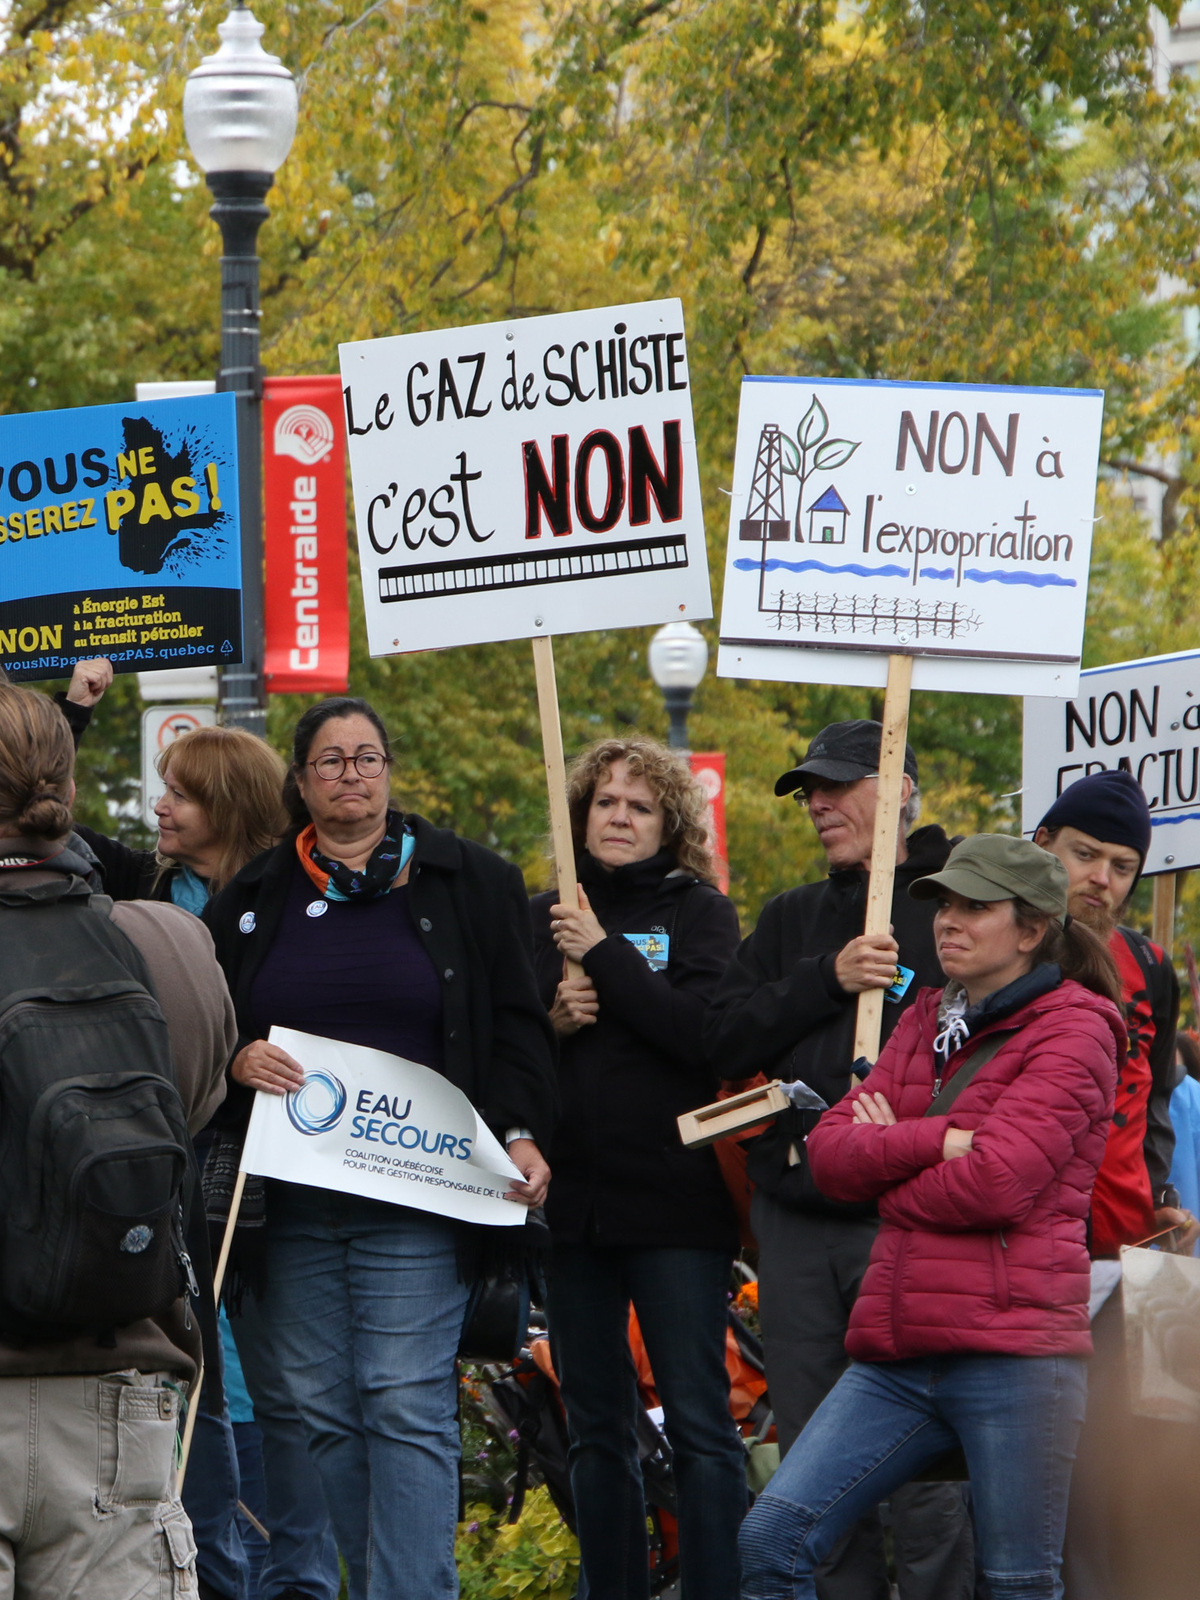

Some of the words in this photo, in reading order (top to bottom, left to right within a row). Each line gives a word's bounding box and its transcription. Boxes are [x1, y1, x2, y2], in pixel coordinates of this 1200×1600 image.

[343, 385, 394, 436] Le
[406, 352, 492, 427] GAZ
[501, 349, 539, 411] de
[543, 322, 688, 407] SCHISTE
[116, 446, 156, 482] NE
[896, 410, 1020, 477] NON
[1036, 436, 1065, 479] à
[367, 451, 495, 555] c'est
[521, 419, 684, 539] NON
[862, 494, 1073, 588] l'expropriation
[290, 476, 319, 671] Centraide
[73, 604, 81, 615] à
[82, 597, 139, 614] Énergie
[141, 593, 165, 609] Est
[82, 620, 93, 631] la
[95, 610, 182, 630] fracturation
[89, 629, 137, 647] transit
[140, 624, 204, 645] pétrolier
[1065, 685, 1160, 752] NON
[356, 1090, 412, 1120] EAU
[350, 1116, 473, 1161] SECOURS
[343, 1158, 367, 1172] POUR
[368, 1164, 386, 1175] UNE
[386, 1168, 424, 1183] GESTION
[424, 1175, 482, 1195] RESPONSABLE
[482, 1187, 496, 1198] DE
[345, 1148, 392, 1165] COALITION
[392, 1157, 445, 1177] QUÉBÉCOISE
